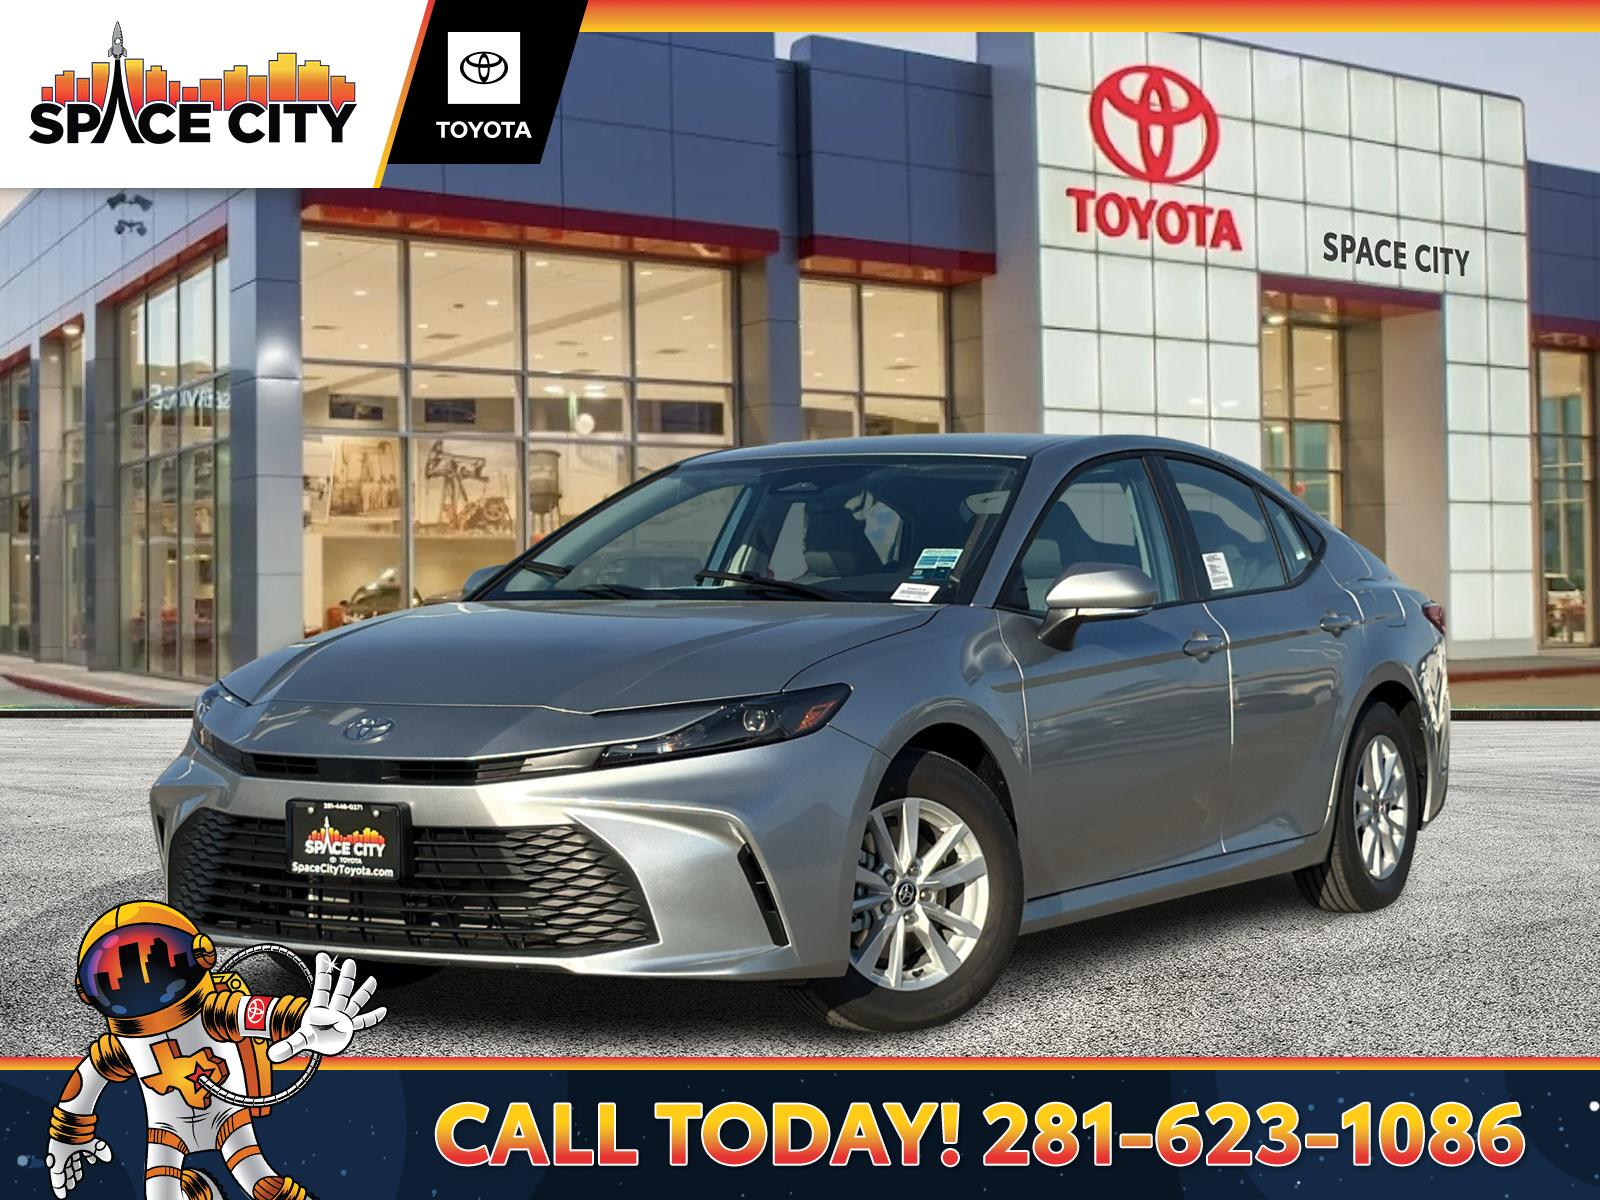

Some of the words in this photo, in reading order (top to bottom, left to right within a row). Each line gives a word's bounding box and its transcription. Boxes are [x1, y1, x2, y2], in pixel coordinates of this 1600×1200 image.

[1066, 187, 1242, 251] TOYOTA
[1323, 232, 1407, 270] SPACE
[1414, 244, 1470, 277] CITY
[304, 833, 351, 856] SPACE
[353, 842, 386, 857] CITY
[291, 861, 394, 878] SpaceCityToyota.com
[339, 857, 363, 865] TOYOTA
